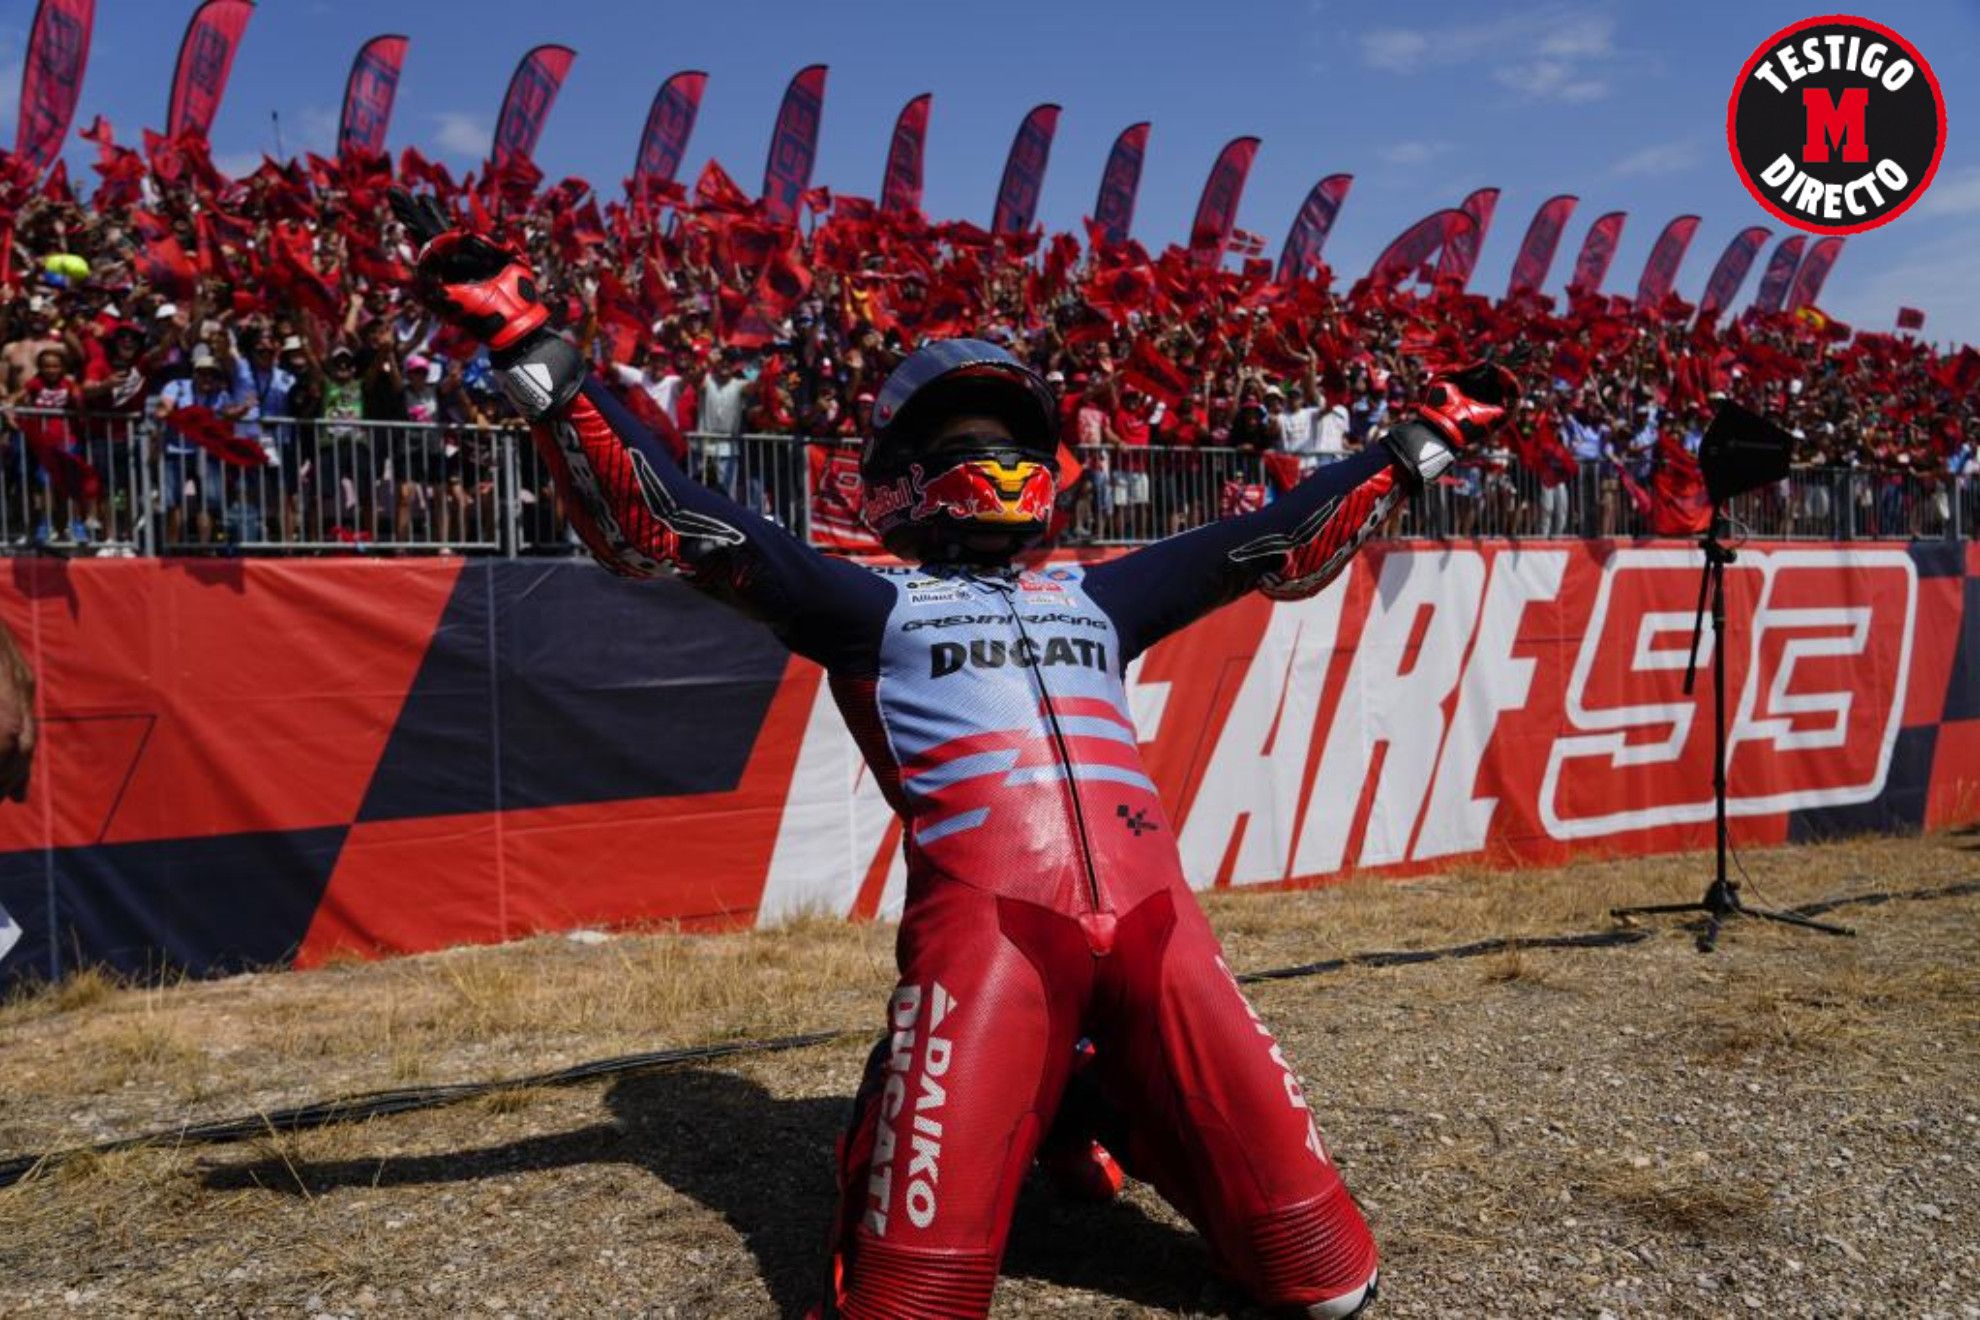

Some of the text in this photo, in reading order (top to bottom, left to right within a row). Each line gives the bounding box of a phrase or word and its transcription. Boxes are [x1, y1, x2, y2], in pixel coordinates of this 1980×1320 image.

[930, 636, 1107, 680] DUCATI
[1179, 548, 1570, 891] ARE
[1539, 547, 1919, 841] 93
[863, 984, 921, 1238] DUCATI
[906, 1036, 952, 1229] DAIKO
